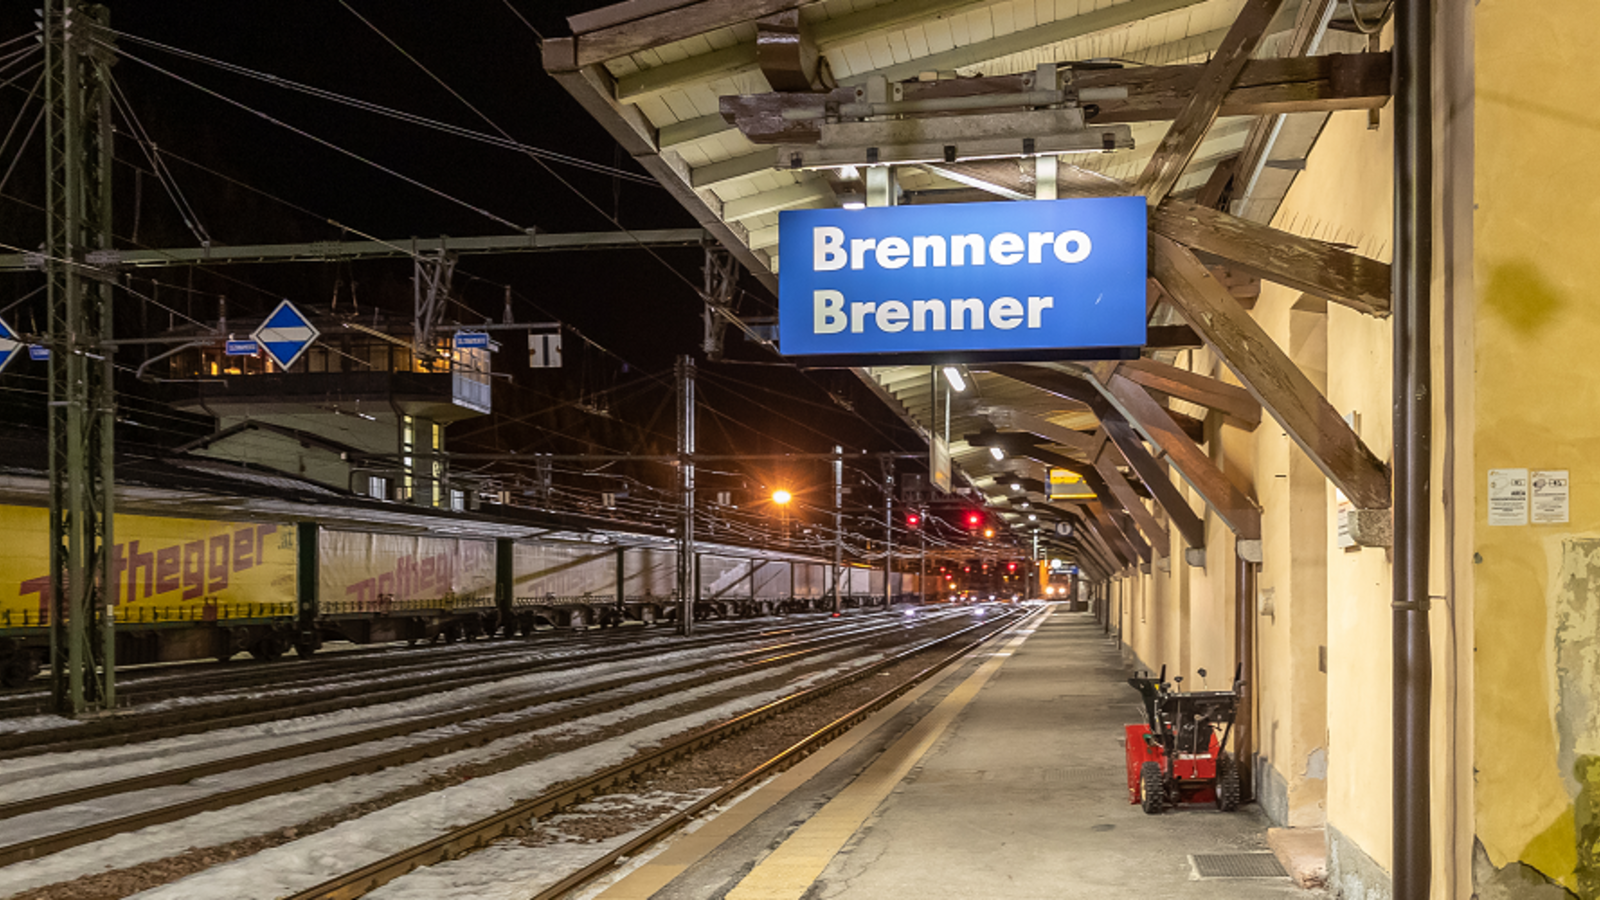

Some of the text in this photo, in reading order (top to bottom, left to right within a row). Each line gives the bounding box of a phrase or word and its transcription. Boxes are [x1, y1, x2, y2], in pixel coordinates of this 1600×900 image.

[813, 226, 1092, 271] Brennero
[813, 289, 1054, 334] Brenner
[19, 523, 277, 625] nthegger
